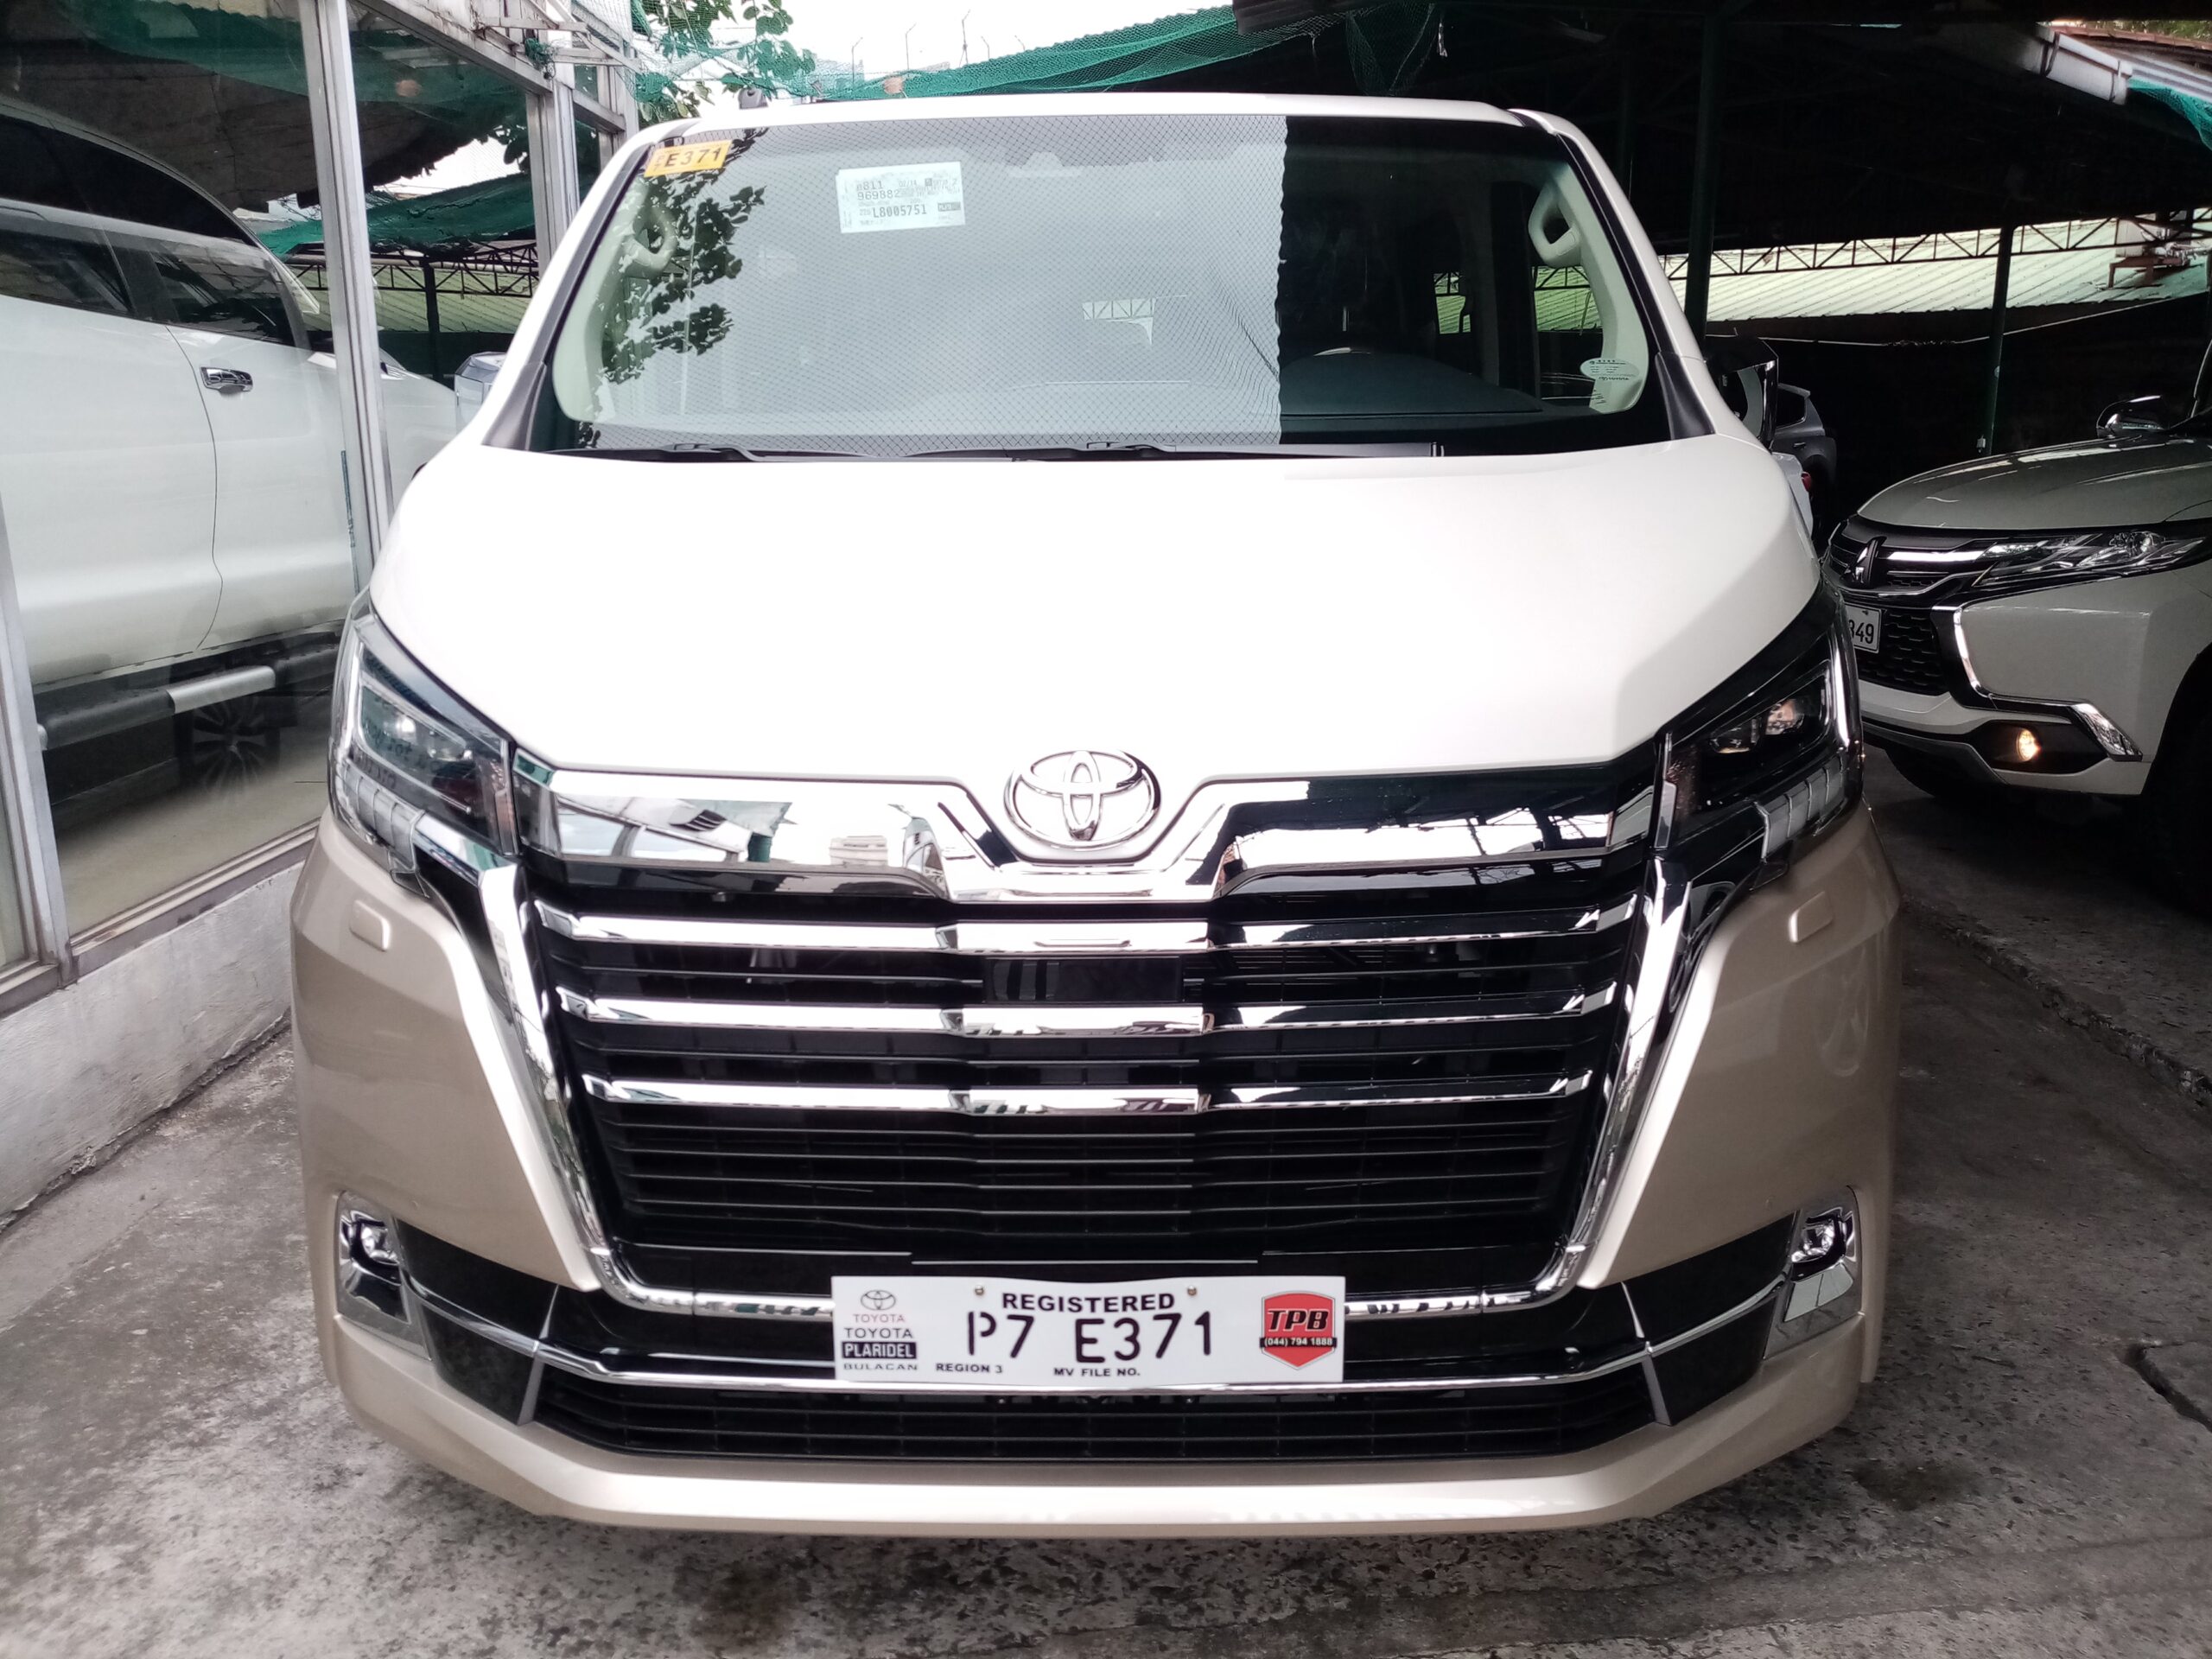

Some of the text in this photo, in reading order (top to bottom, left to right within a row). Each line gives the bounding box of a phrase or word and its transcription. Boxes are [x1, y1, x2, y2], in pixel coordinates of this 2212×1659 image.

[664, 147, 721, 167] E371
[857, 189, 900, 201] 969882
[872, 204, 928, 218] L8005751
[1002, 1293, 1175, 1313] REGISTERED
[853, 1313, 906, 1324] TOYOTA
[1267, 1308, 1330, 1332] TPB
[844, 1327, 913, 1338] TOYOTA
[968, 1310, 1211, 1363] P7 E371
[1263, 1337, 1333, 1347] (044) 794 1888
[844, 1343, 914, 1358] PLARIDEL
[936, 1363, 1003, 1374] REGION 3
[1053, 1367, 1141, 1376] MV FILE NO.
